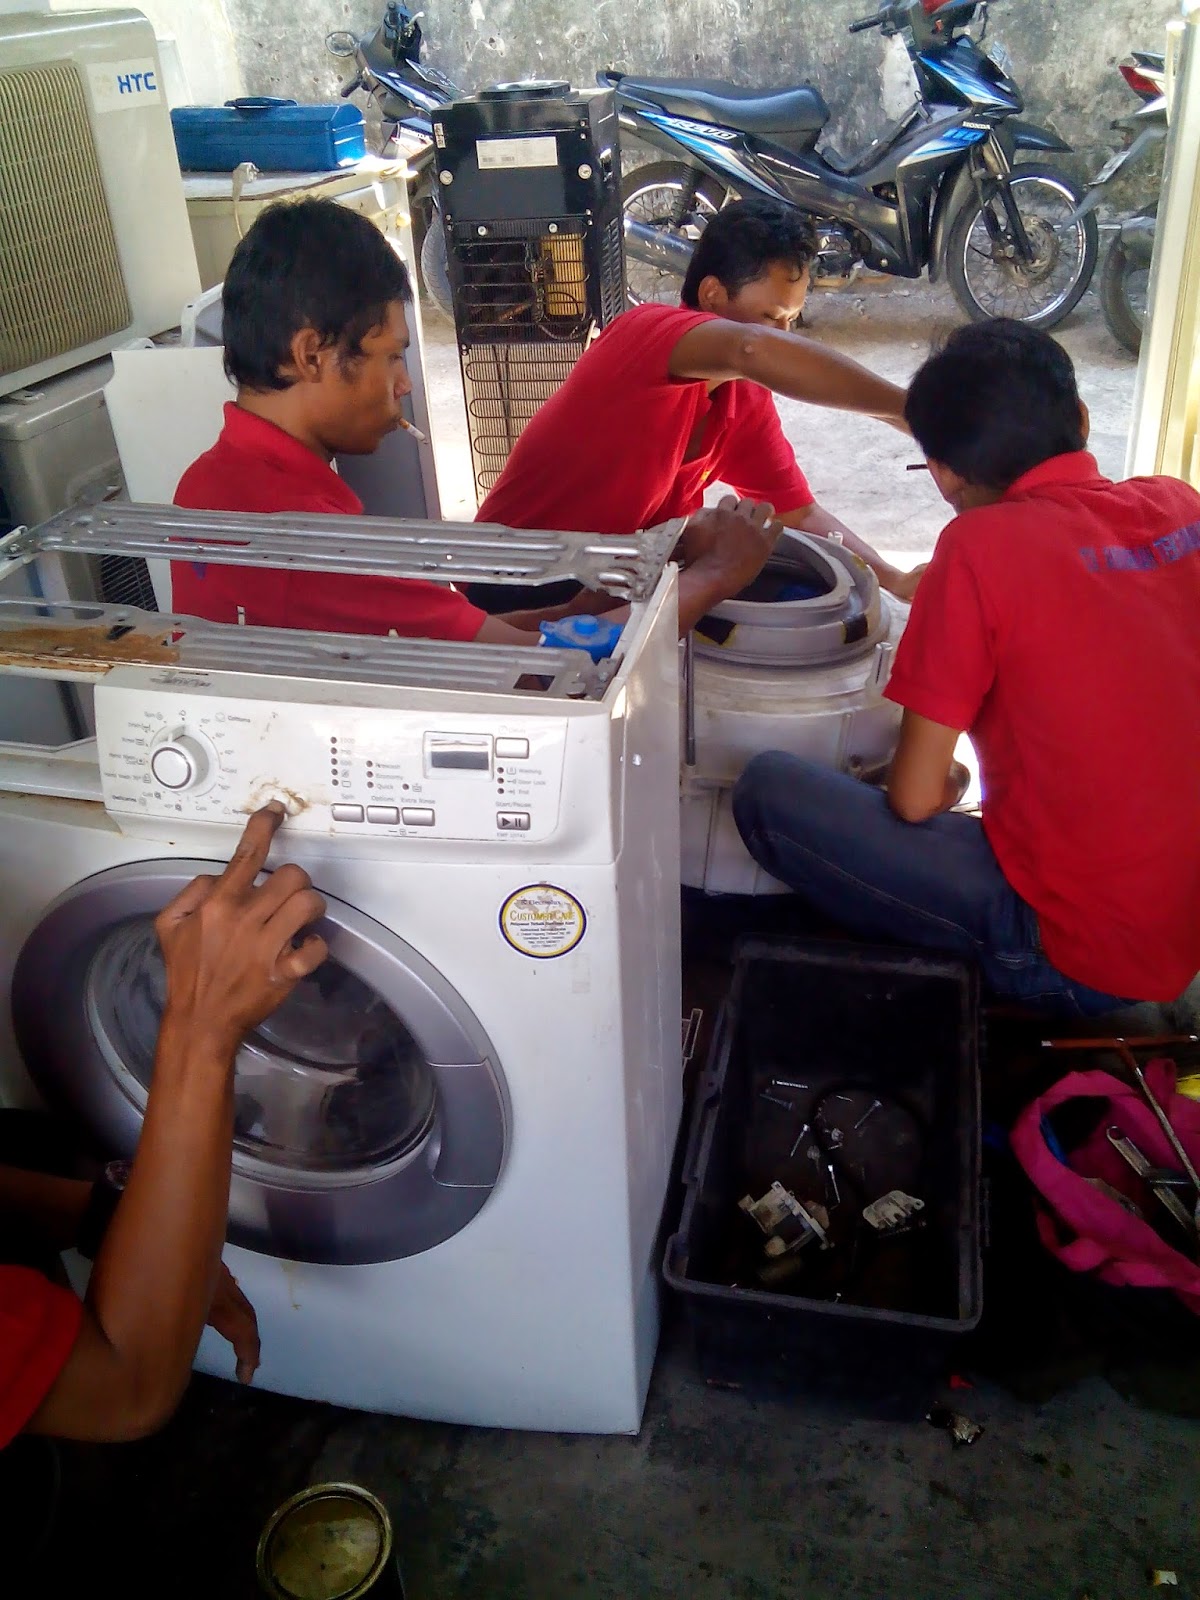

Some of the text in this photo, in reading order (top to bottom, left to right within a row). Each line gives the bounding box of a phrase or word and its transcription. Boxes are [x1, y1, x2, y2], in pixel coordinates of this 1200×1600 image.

[117, 71, 157, 94] HTC
[962, 121, 991, 130] HONDA
[376, 783, 394, 791] Quick
[371, 795, 395, 803] Options
[495, 801, 532, 809] Start/Pause
